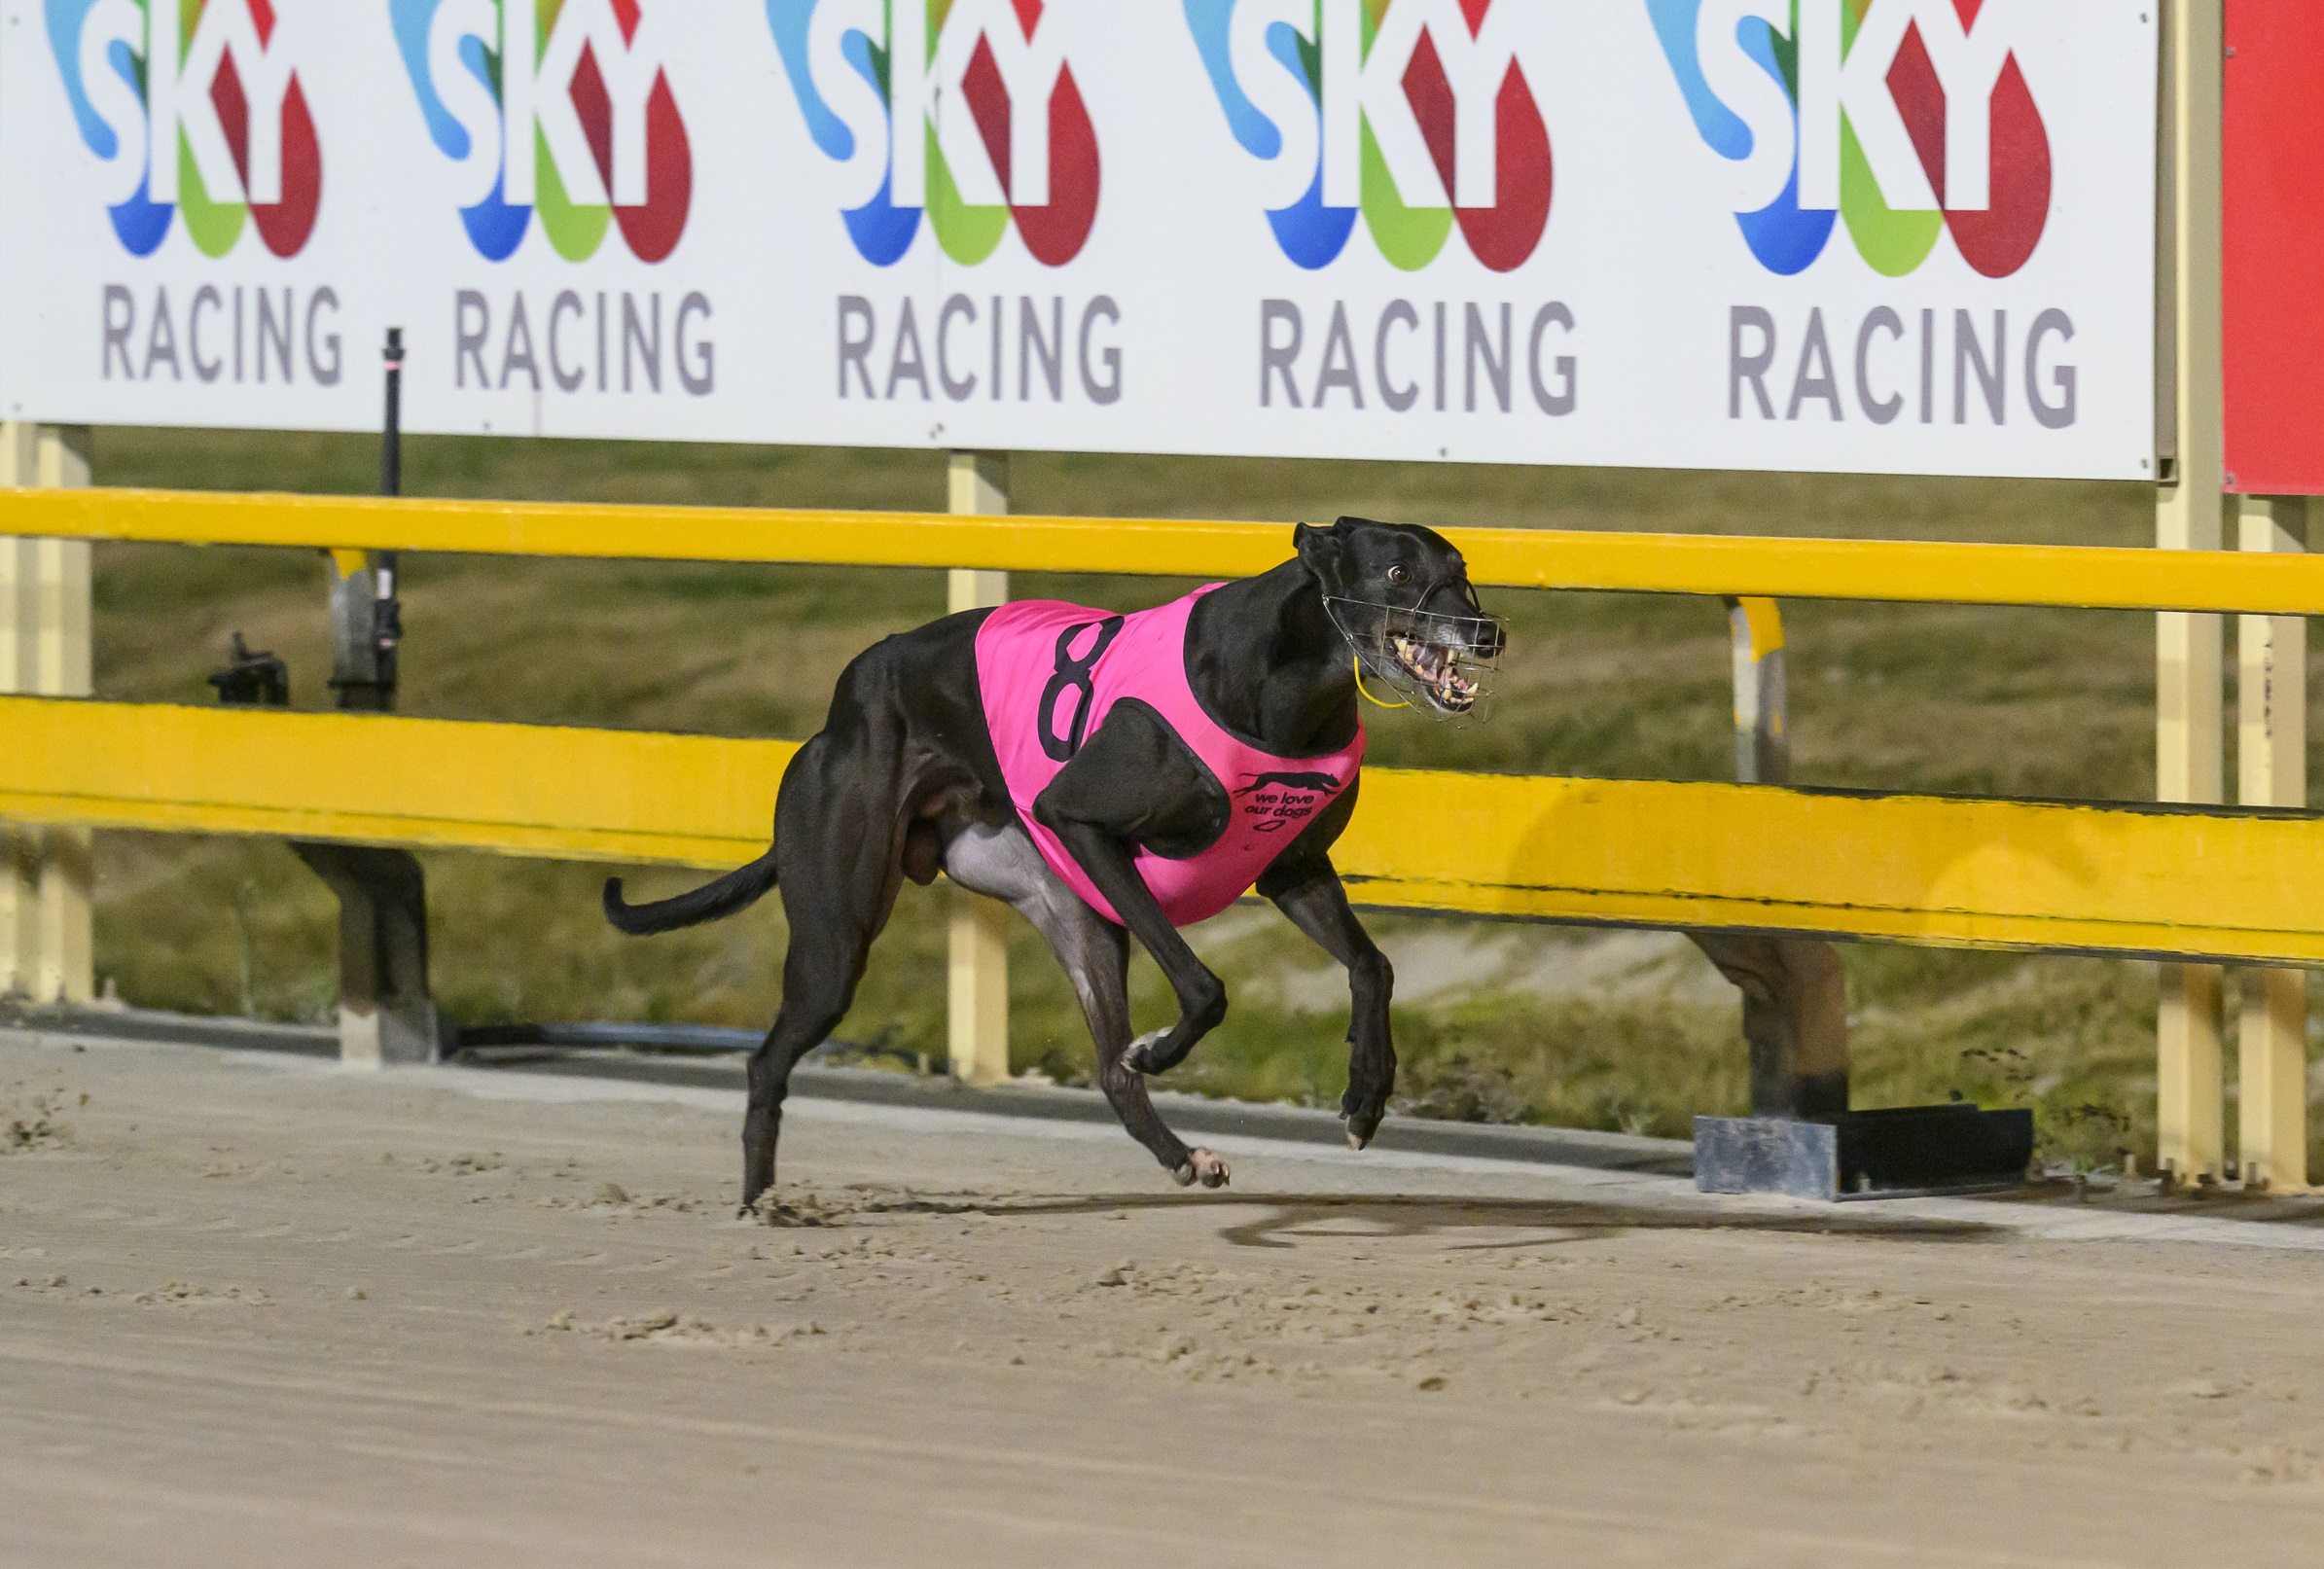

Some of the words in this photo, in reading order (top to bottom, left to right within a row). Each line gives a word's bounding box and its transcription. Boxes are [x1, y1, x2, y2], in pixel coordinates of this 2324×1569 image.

[78, 0, 316, 207] SKY
[429, 0, 685, 208] SKY
[807, 0, 1085, 210] SKY
[1229, 0, 1533, 211] SKY
[1696, 0, 2031, 213] SKY
[101, 284, 342, 386] RACING
[454, 289, 715, 397] RACING
[837, 293, 1123, 406] RACING
[1259, 298, 1578, 417] RACING
[1728, 304, 2078, 430] RACING
[1037, 616, 1126, 763] 8
[1245, 805, 1272, 814] our
[1272, 805, 1313, 819] dogs
[1255, 793, 1279, 803] we
[1280, 792, 1314, 804] love
